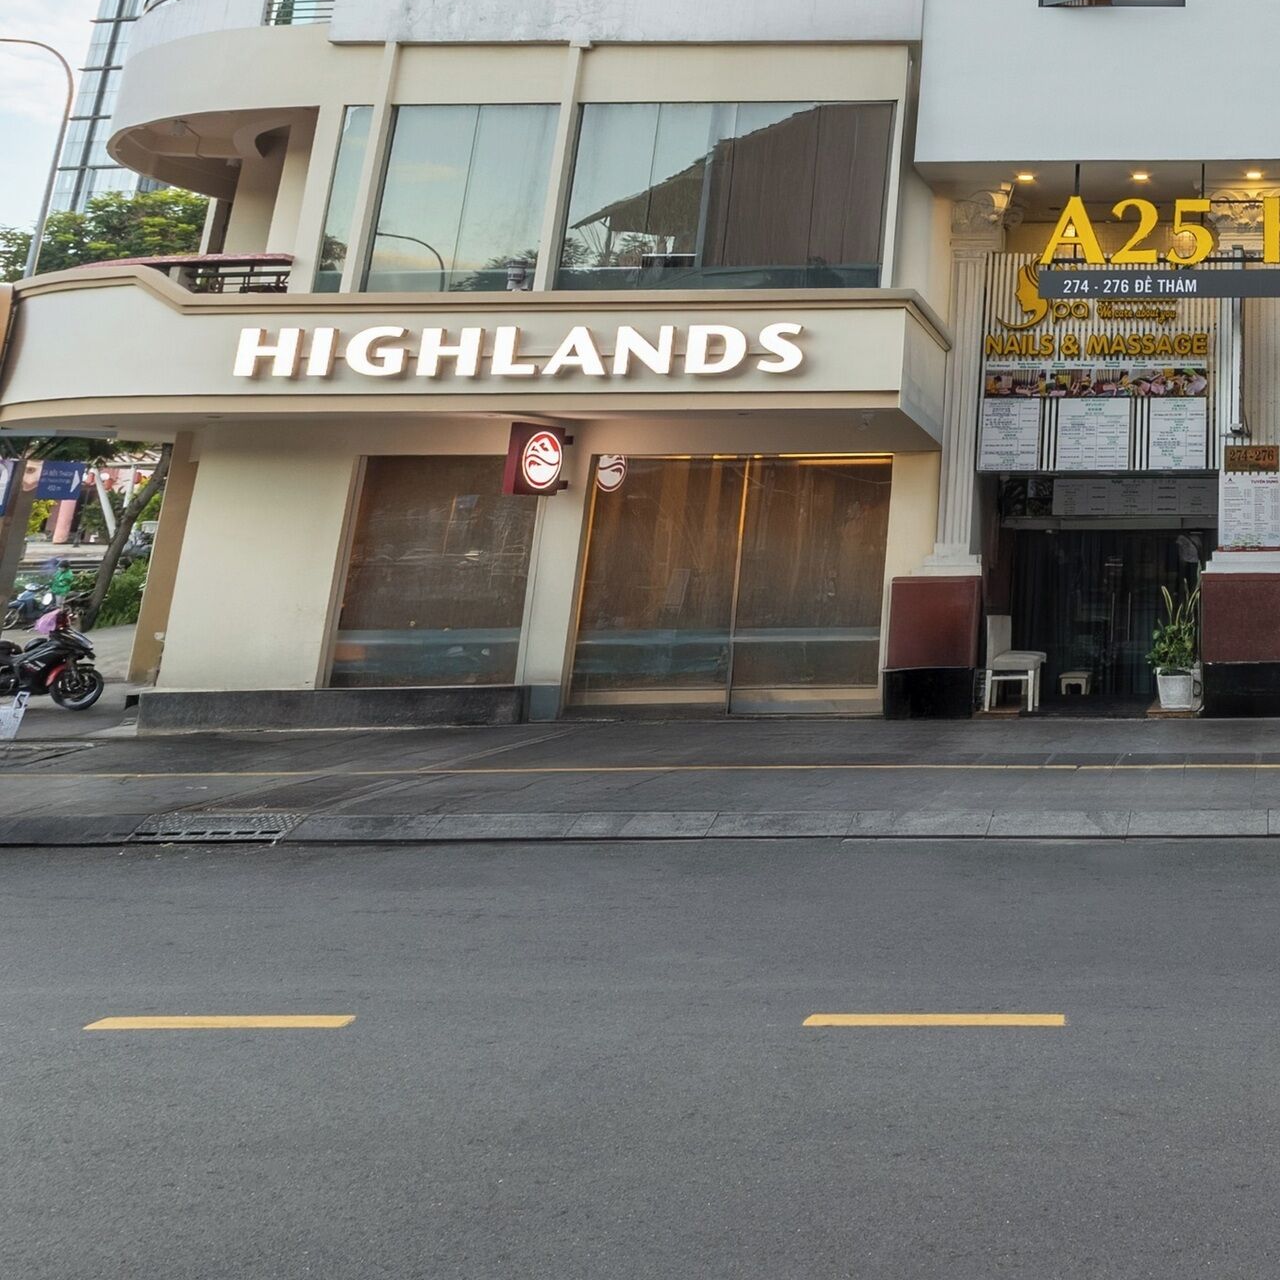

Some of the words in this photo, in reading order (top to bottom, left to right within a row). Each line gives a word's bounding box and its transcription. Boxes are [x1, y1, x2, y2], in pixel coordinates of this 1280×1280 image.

[1040, 196, 1214, 265] A25
[1063, 279, 1089, 293] 274
[1103, 279, 1129, 293] 276
[232, 323, 804, 378] HIGHLANDS
[985, 334, 1054, 356] NAILS
[1061, 334, 1080, 355] &
[1086, 334, 1209, 356] MASSAGE
